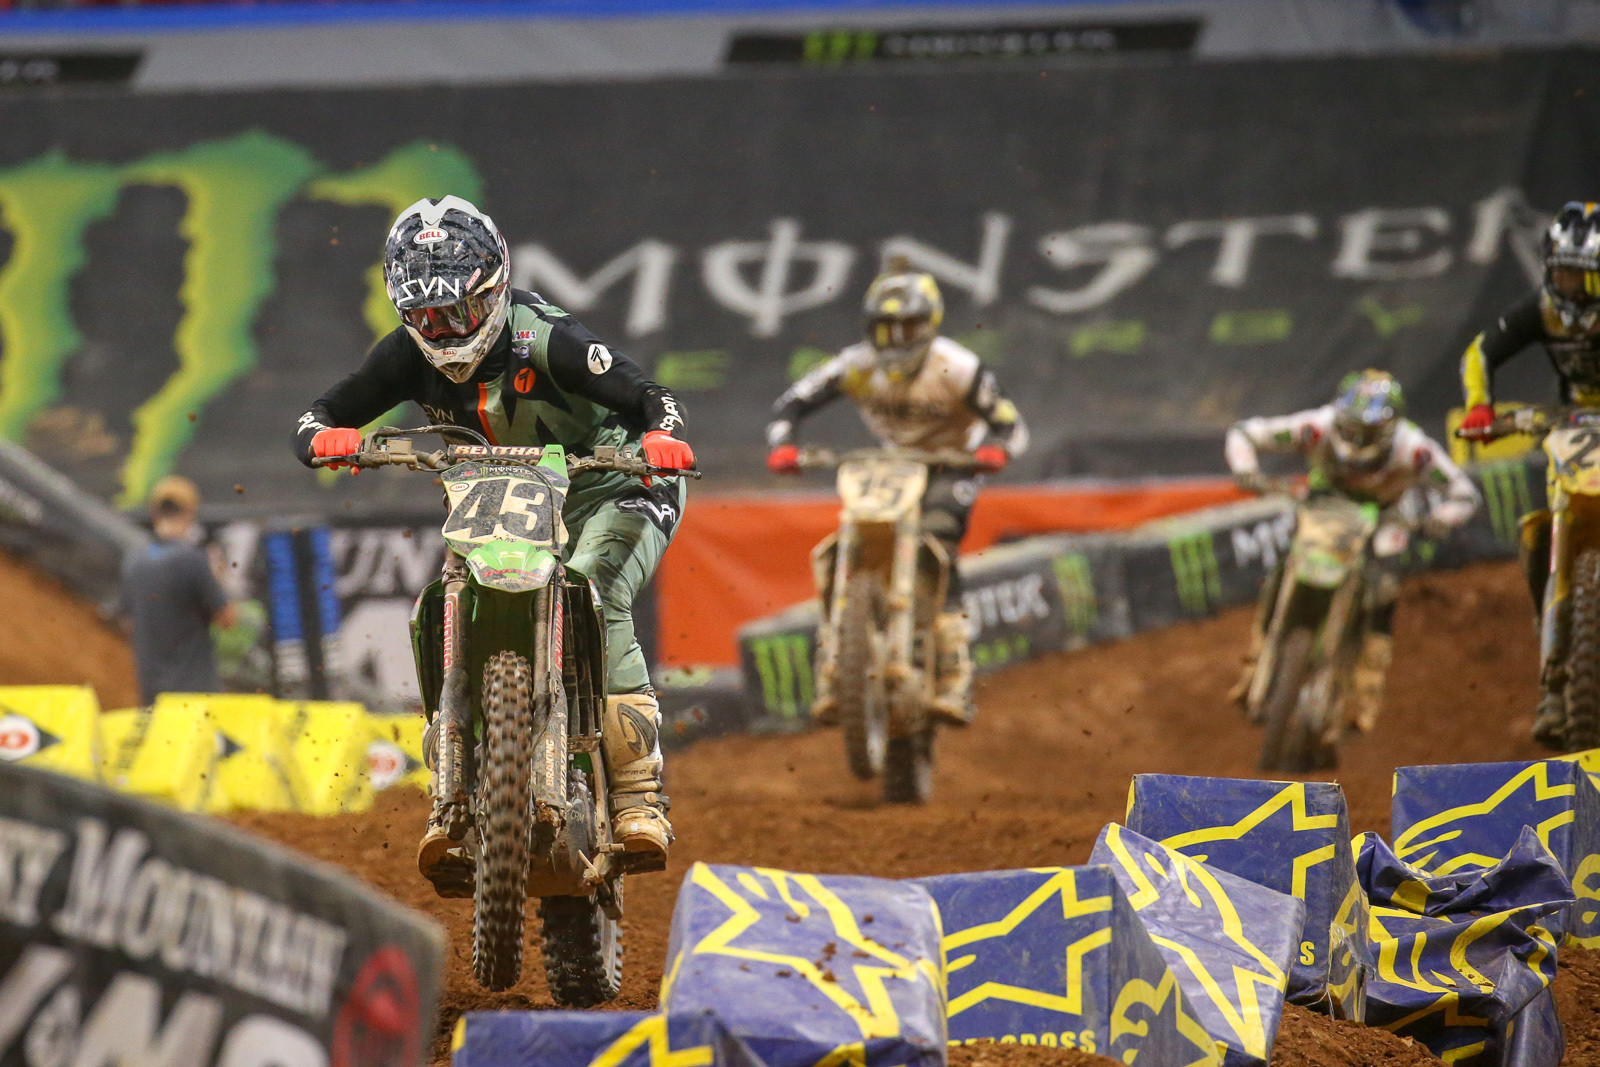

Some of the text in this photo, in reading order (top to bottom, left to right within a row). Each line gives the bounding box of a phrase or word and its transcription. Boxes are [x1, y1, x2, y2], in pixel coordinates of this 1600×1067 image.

[418, 231, 443, 241] BELL
[454, 445, 546, 457] RENTHA
[444, 478, 566, 541] 43
[545, 739, 555, 787] BRAKING
